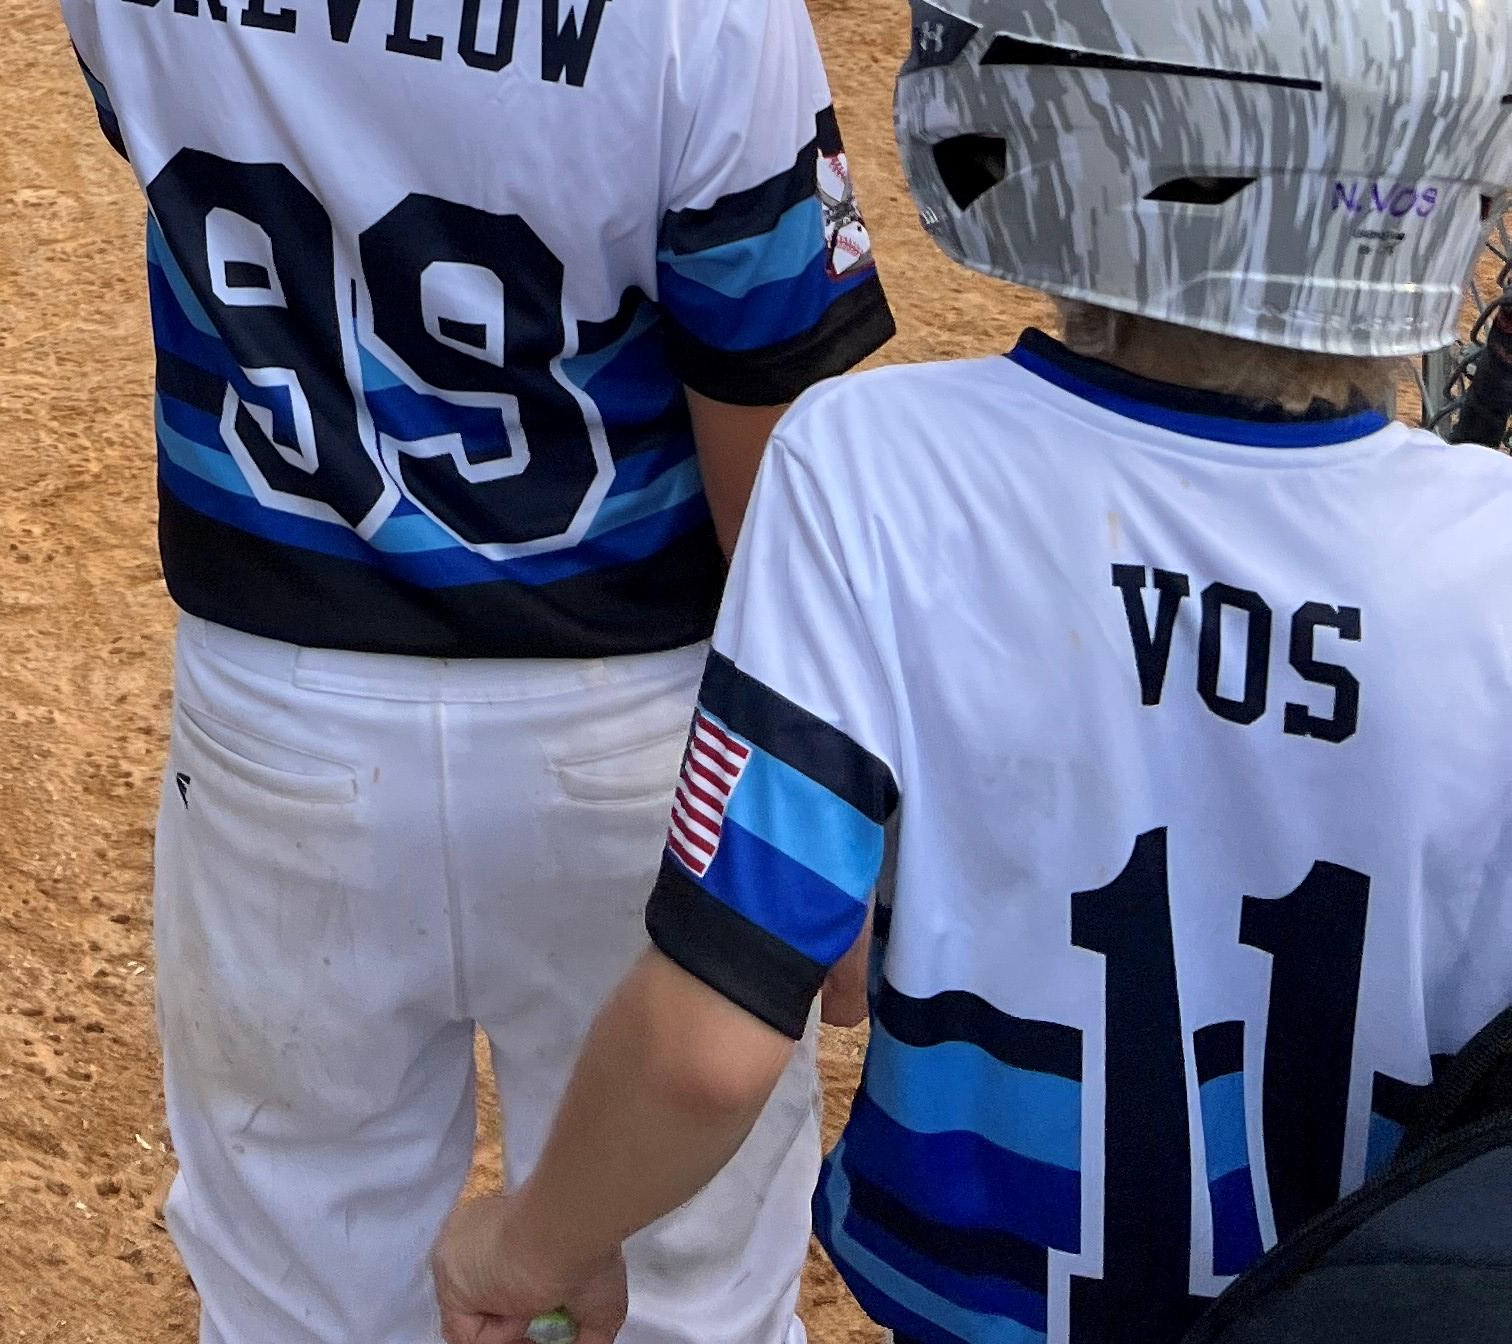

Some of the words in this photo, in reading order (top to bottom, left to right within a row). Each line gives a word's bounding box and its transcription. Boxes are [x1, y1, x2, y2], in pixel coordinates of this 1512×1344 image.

[144, 144, 616, 562] 99
[1111, 563, 1363, 744] VOS
[1050, 825, 1374, 1344] 11
